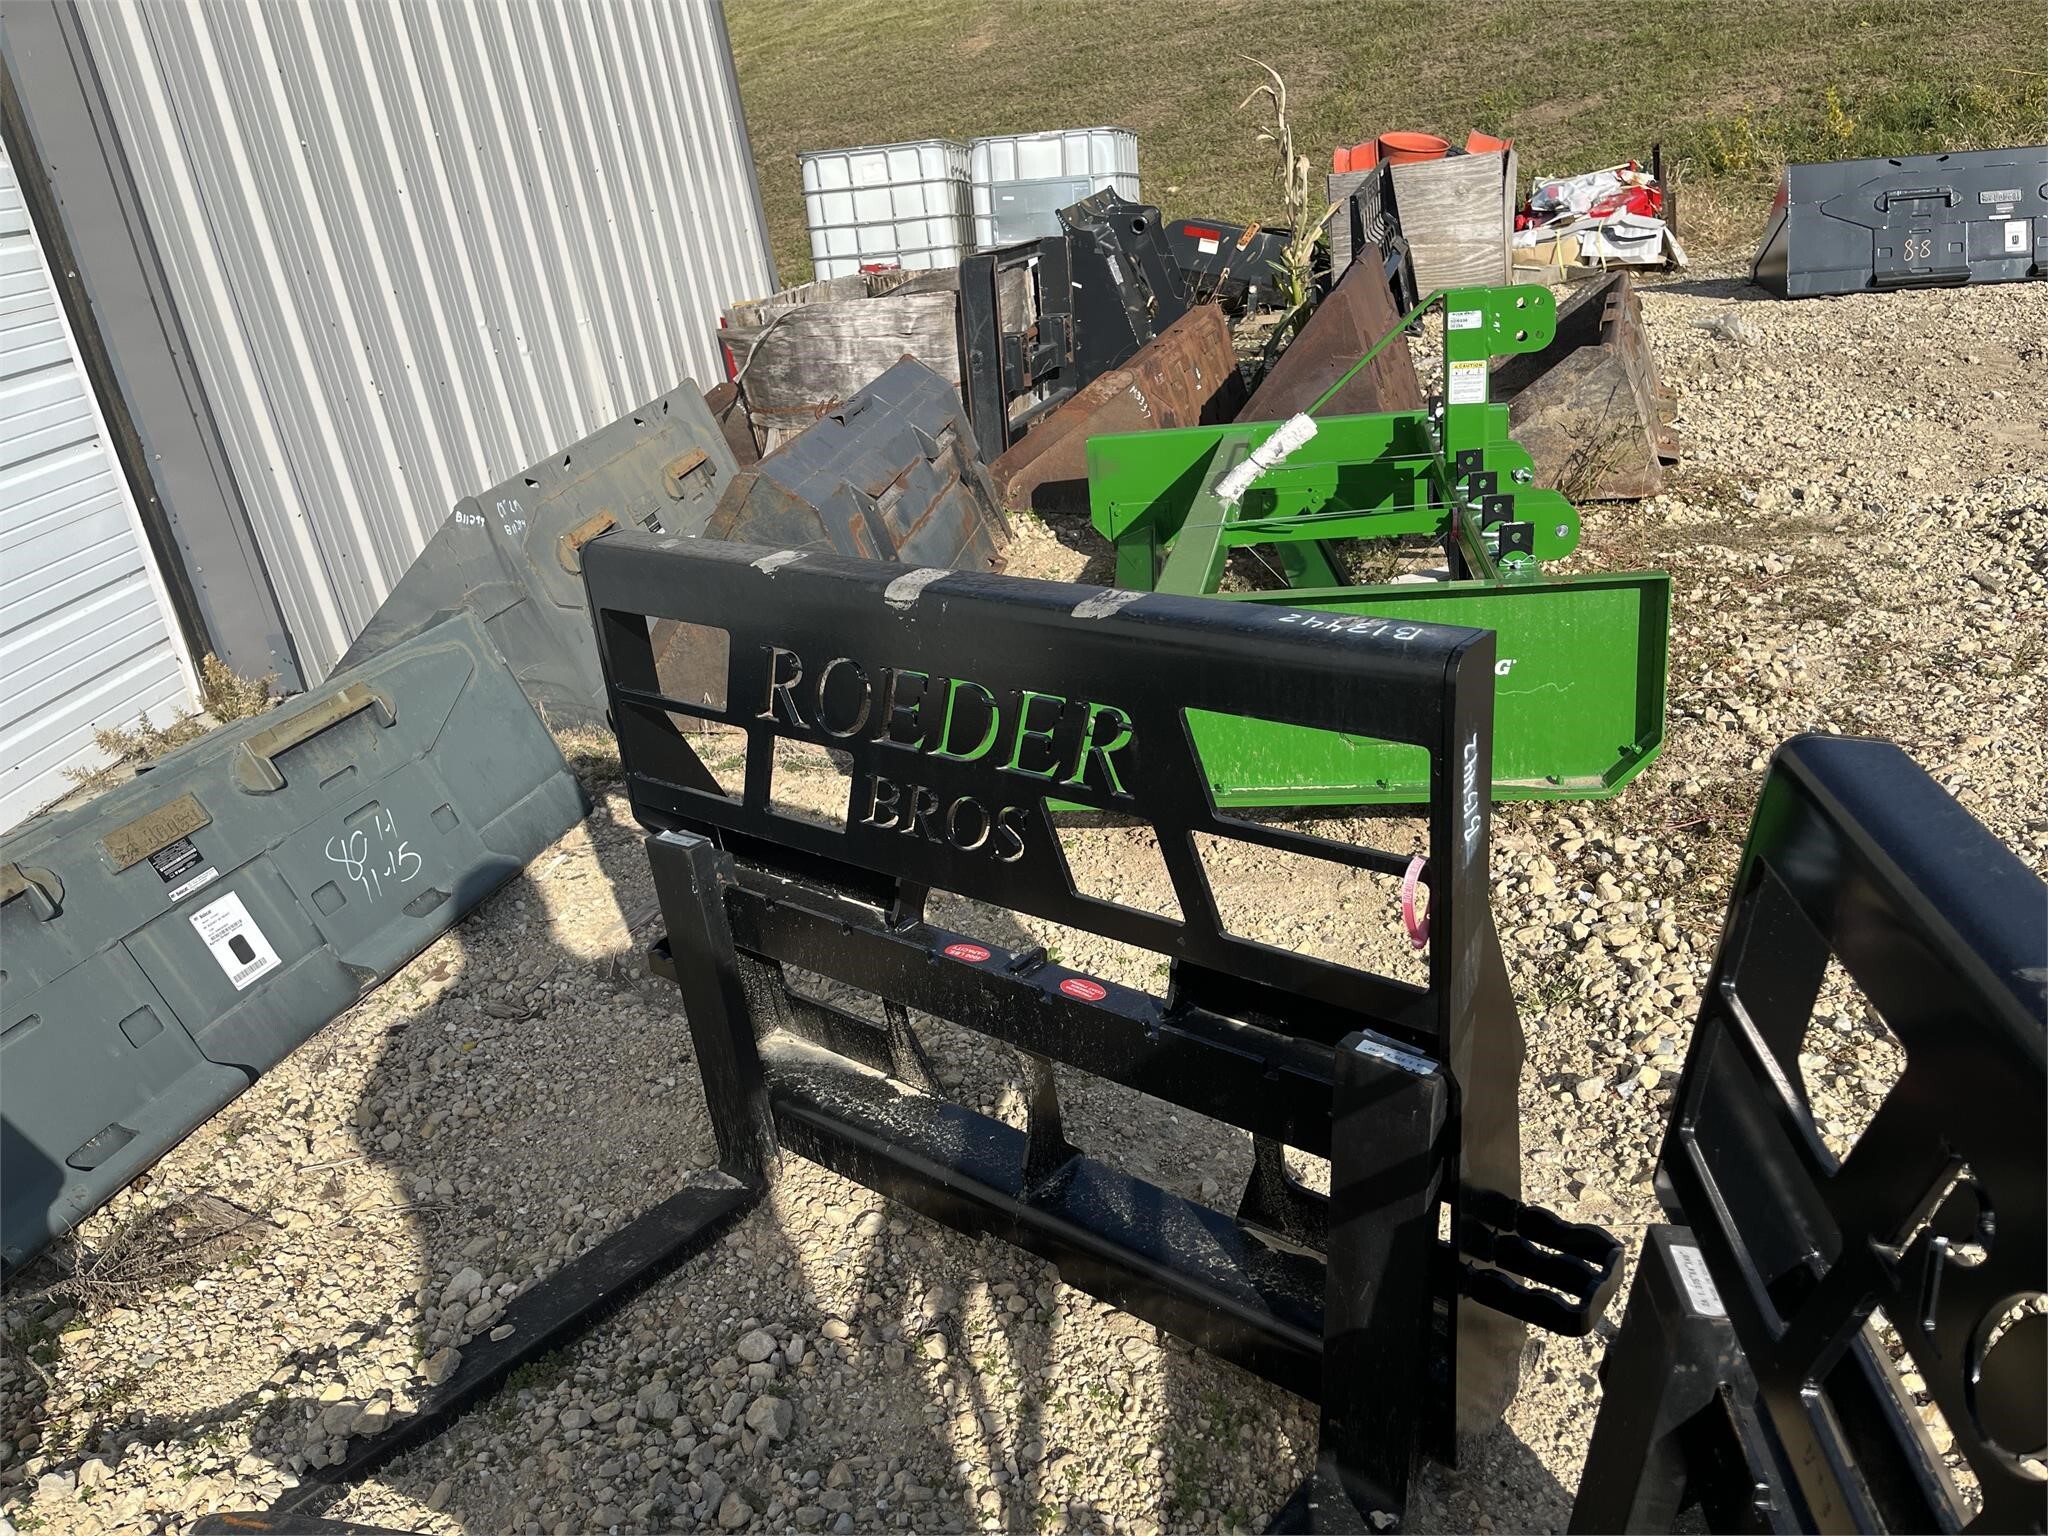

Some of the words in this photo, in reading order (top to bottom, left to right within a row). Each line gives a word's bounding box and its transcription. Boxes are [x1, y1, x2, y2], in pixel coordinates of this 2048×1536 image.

[1903, 239, 1931, 262] 8-8
[1278, 613, 1425, 641] B13442
[755, 643, 1135, 800] ROEDER
[859, 774, 1030, 863] BROS
